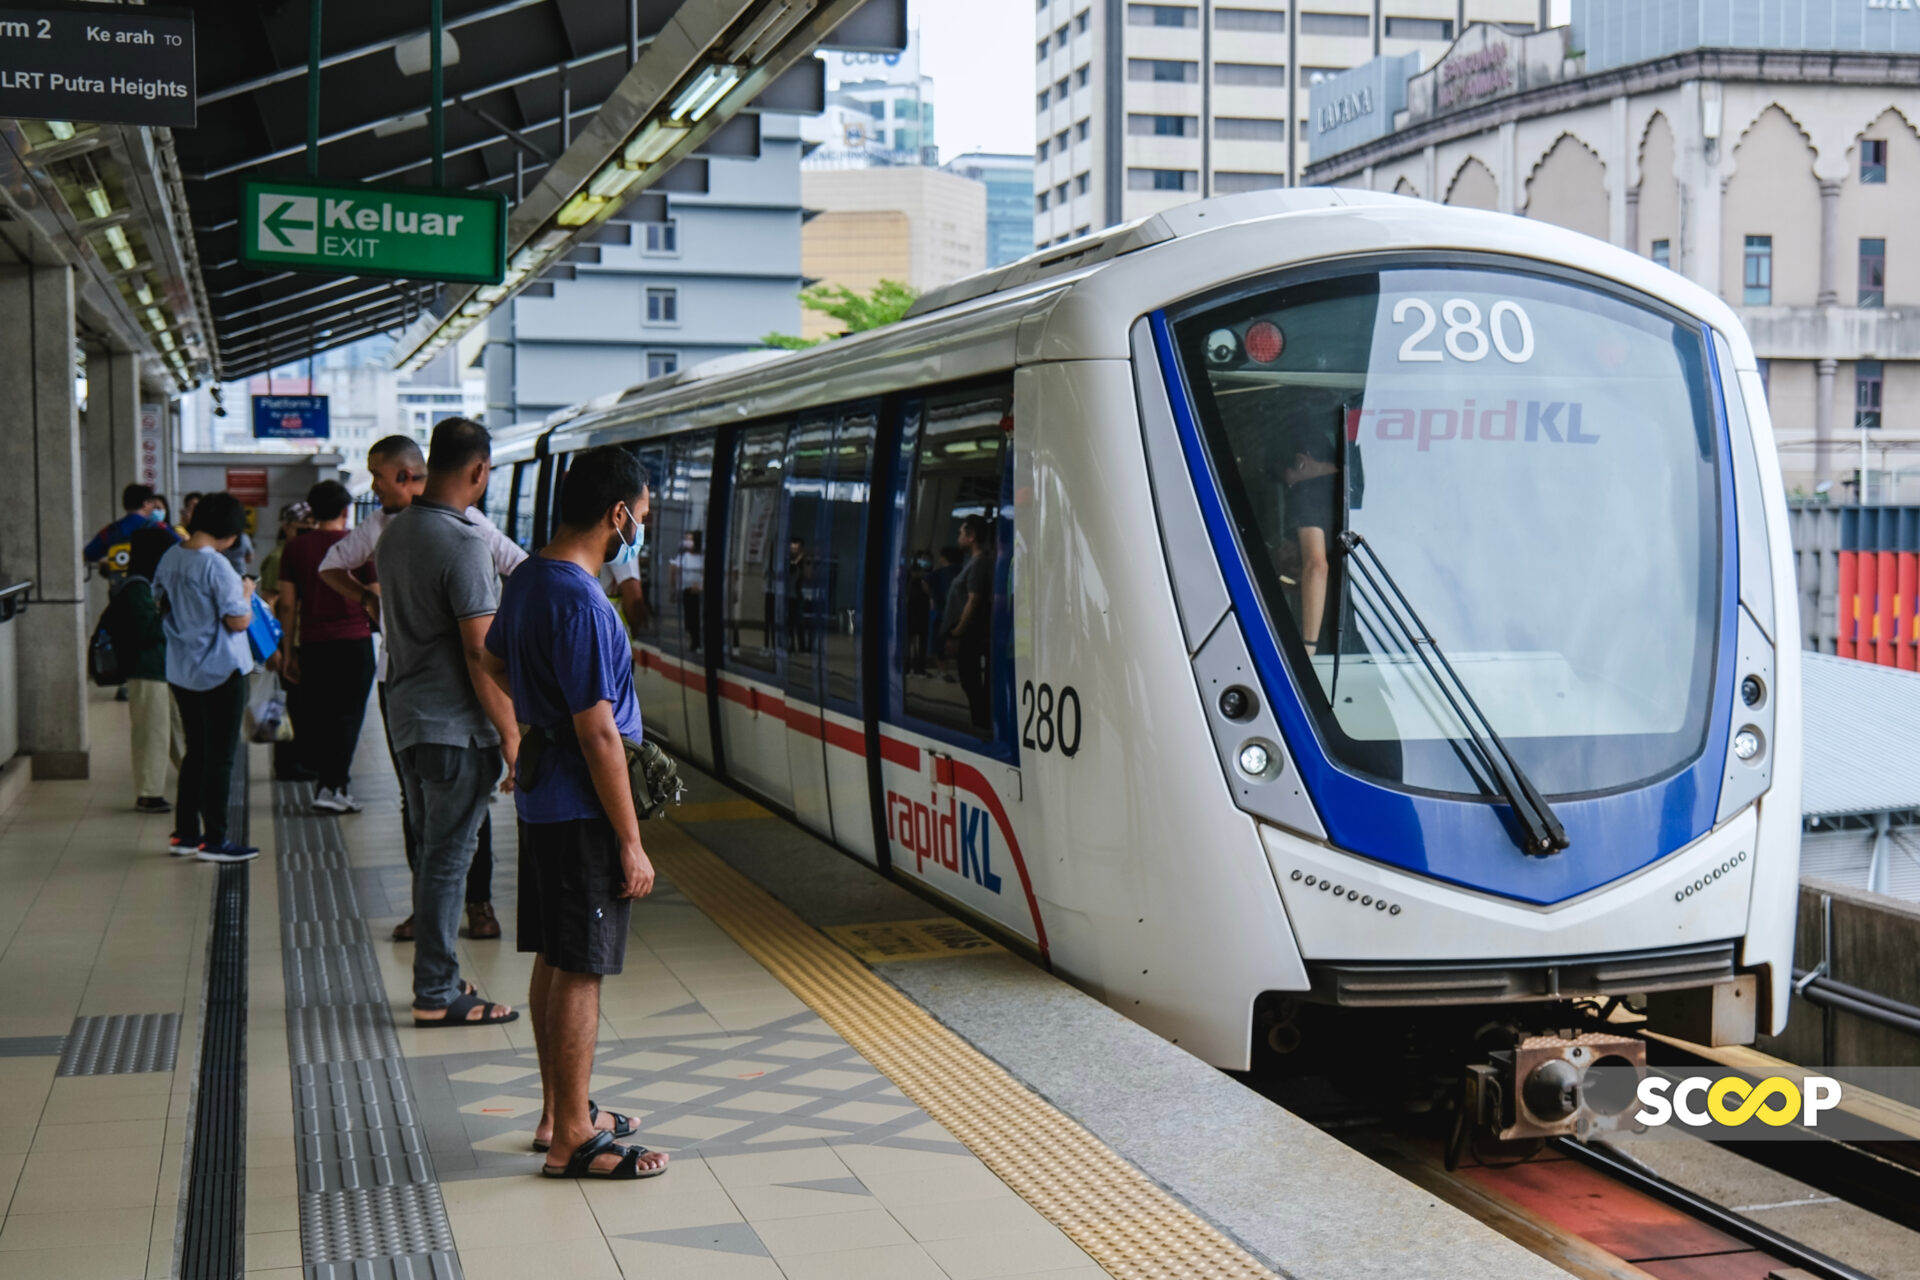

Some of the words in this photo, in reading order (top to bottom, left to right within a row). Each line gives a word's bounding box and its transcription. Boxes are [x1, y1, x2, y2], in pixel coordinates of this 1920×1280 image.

[36, 18, 53, 40] 2
[86, 26, 111, 42] Ke
[115, 30, 155, 45] arah
[163, 34, 182, 46] TO
[1, 71, 44, 90] LRT
[50, 73, 105, 93] Putra
[111, 76, 188, 100] Heights
[1317, 87, 1374, 134] LAVANA
[325, 198, 464, 236] Keluar
[323, 236, 380, 259] EXIT
[1392, 297, 1535, 364] 280
[1347, 399, 1600, 452] rapidKL
[1022, 680, 1082, 757] 280
[887, 790, 1002, 895] rapidKL
